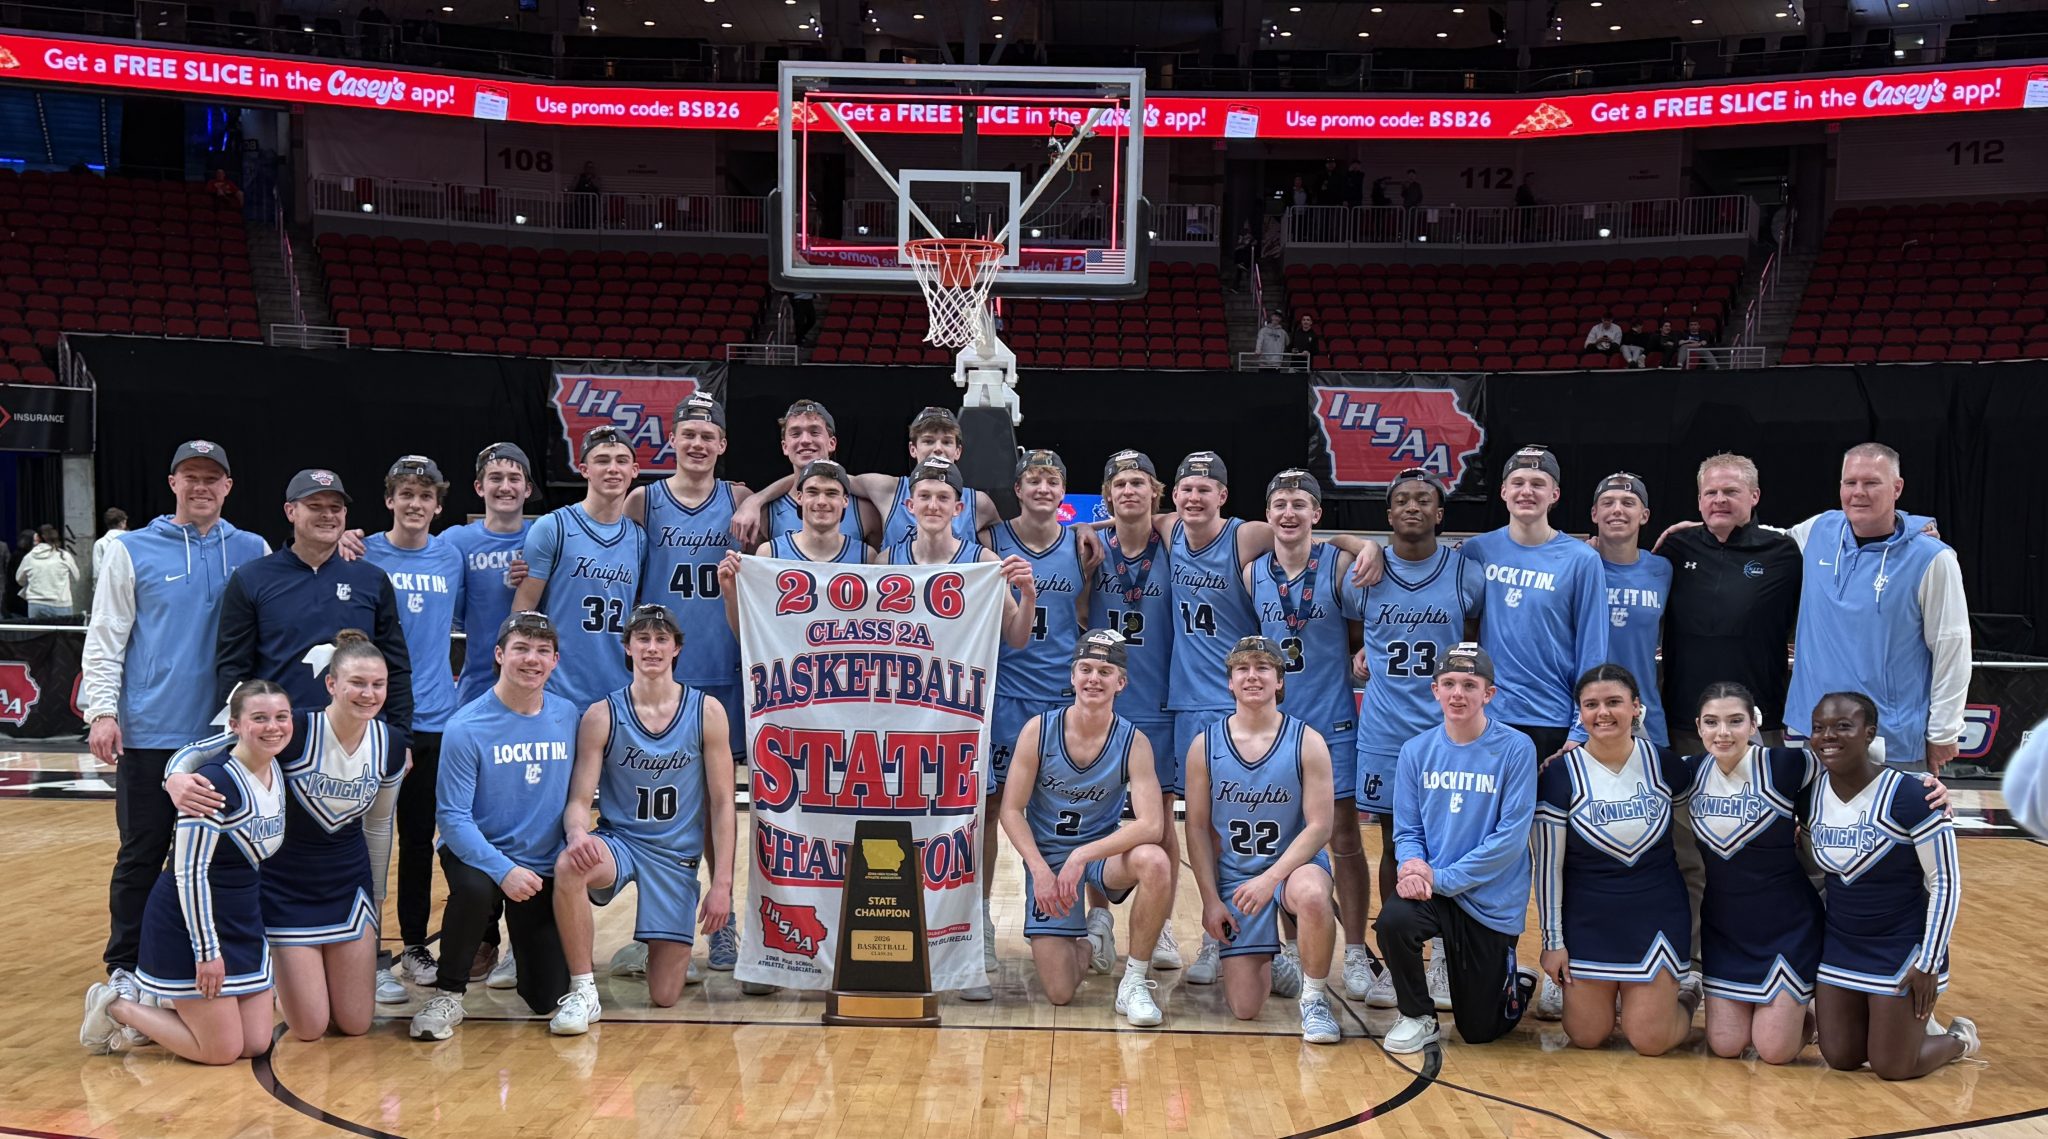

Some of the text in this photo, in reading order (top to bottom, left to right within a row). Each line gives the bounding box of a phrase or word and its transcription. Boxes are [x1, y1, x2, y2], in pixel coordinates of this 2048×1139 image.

[44, 48, 455, 109] Get a FREE SLICE in the Casey's app!
[535, 96, 740, 118] Use promo code: BSB26
[1591, 78, 2001, 122] Get a FREE SLICE in the Casey's app!
[838, 102, 874, 122] Get
[880, 108, 890, 122] a
[898, 103, 951, 123] FREE
[1026, 107, 1043, 124] in
[1048, 108, 1082, 125] the
[1165, 108, 1207, 131] app!
[1286, 110, 1491, 131] Use promo code: BSB26
[498, 147, 553, 172] 108
[1946, 140, 2004, 165] 112
[1460, 167, 1514, 189] 112
[13, 413, 64, 423] INSURANCE
[1328, 393, 1453, 477] IHSAA
[657, 526, 731, 555] Knights
[469, 553, 508, 570] LOCK
[416, 574, 431, 591] IT
[432, 576, 448, 594] IN.
[668, 562, 721, 600] 40
[775, 569, 966, 619] 2026
[1171, 564, 1229, 596] Knights
[1518, 570, 1536, 588] IT
[1533, 572, 1556, 592] IN.
[1624, 588, 1639, 606] IT
[1641, 590, 1661, 609] IN.
[581, 595, 624, 634] 32
[1108, 609, 1146, 647] 12
[1180, 601, 1217, 637] 14
[1375, 603, 1451, 633] Knights
[806, 618, 934, 650] CLASS 2A
[1386, 640, 1438, 678] 23
[750, 650, 986, 724] BASKETBALL
[494, 742, 568, 764] LOCK IT IN.
[618, 746, 691, 780] Knights
[753, 723, 980, 816] STATE
[1424, 771, 1497, 794] LOCK IT IN.
[636, 785, 679, 822] 10
[1216, 780, 1291, 813] Knights
[1056, 810, 1082, 836] 2
[1228, 819, 1280, 857] 22
[854, 908, 910, 918] CHAMPION
[868, 897, 897, 905] STATE
[765, 902, 814, 951] IHSAA
[857, 943, 908, 951] BASKETBALL
